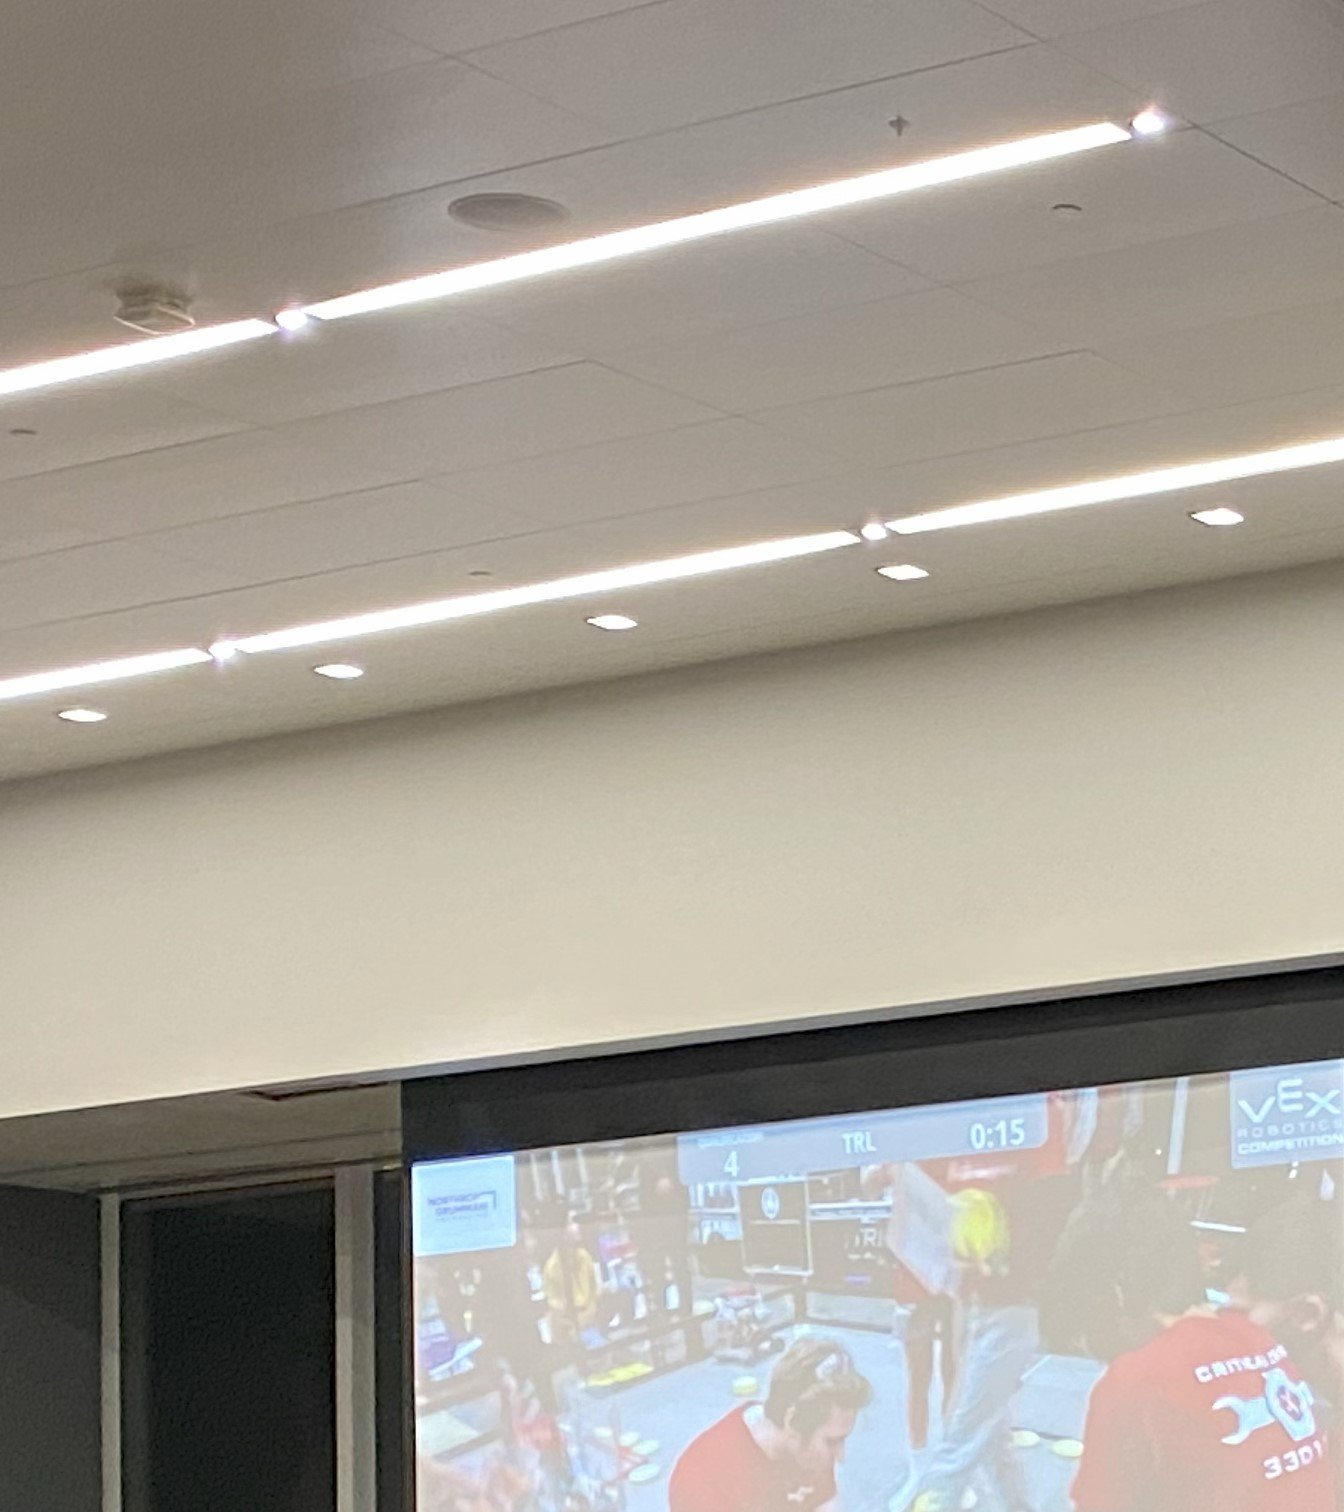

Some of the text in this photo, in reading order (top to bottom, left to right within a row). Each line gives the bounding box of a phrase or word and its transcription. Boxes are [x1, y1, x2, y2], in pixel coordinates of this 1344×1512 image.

[1238, 1078, 1341, 1123] VEX
[970, 1118, 1025, 1149] 0:15
[1237, 1119, 1343, 1138] ROBOTICS
[842, 1131, 876, 1154] TRL
[1237, 1134, 1344, 1155] COMPETITION
[723, 1150, 740, 1177] 4
